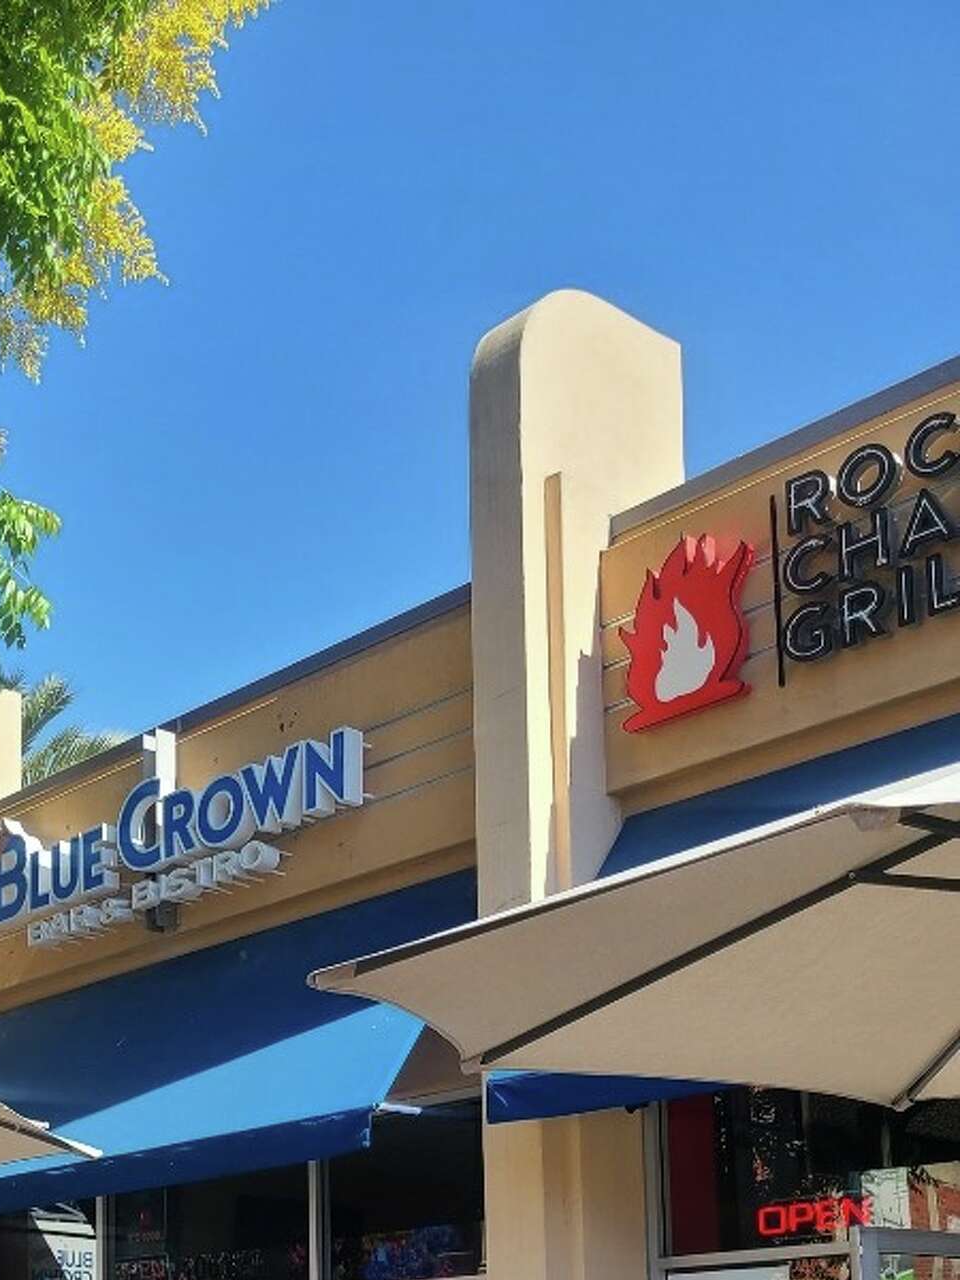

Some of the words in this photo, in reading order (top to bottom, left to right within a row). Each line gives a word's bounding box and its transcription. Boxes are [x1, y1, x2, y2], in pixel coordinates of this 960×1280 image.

[783, 489, 955, 595] CHA
[783, 554, 960, 662] GRIL
[117, 728, 362, 871] CROWN
[132, 840, 281, 911] BISTRO
[758, 1197, 871, 1235] OPEN
